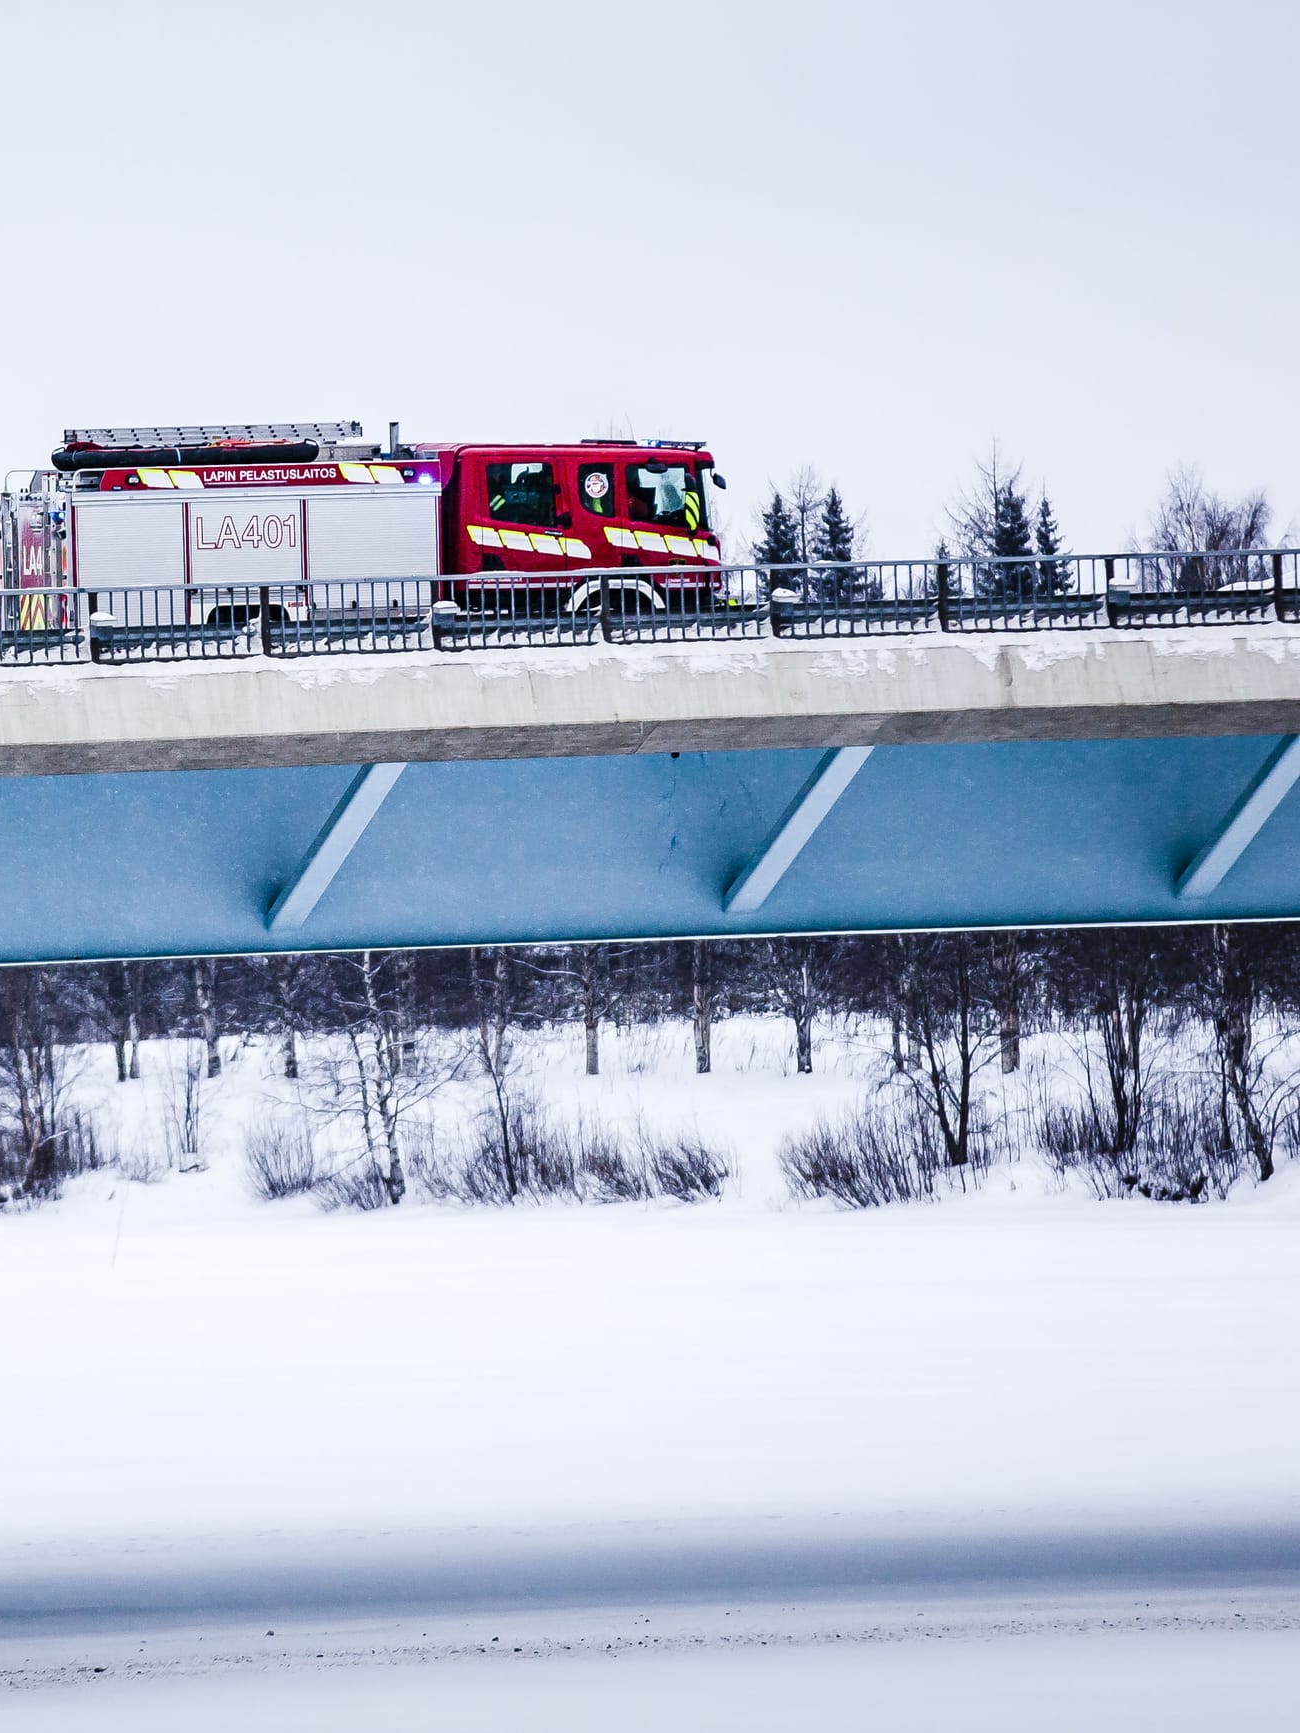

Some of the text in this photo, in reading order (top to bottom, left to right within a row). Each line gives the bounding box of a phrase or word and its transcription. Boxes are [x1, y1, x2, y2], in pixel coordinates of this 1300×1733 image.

[203, 468, 337, 481] LAPIN PELASTUSLAITOS
[196, 514, 296, 549] LA401
